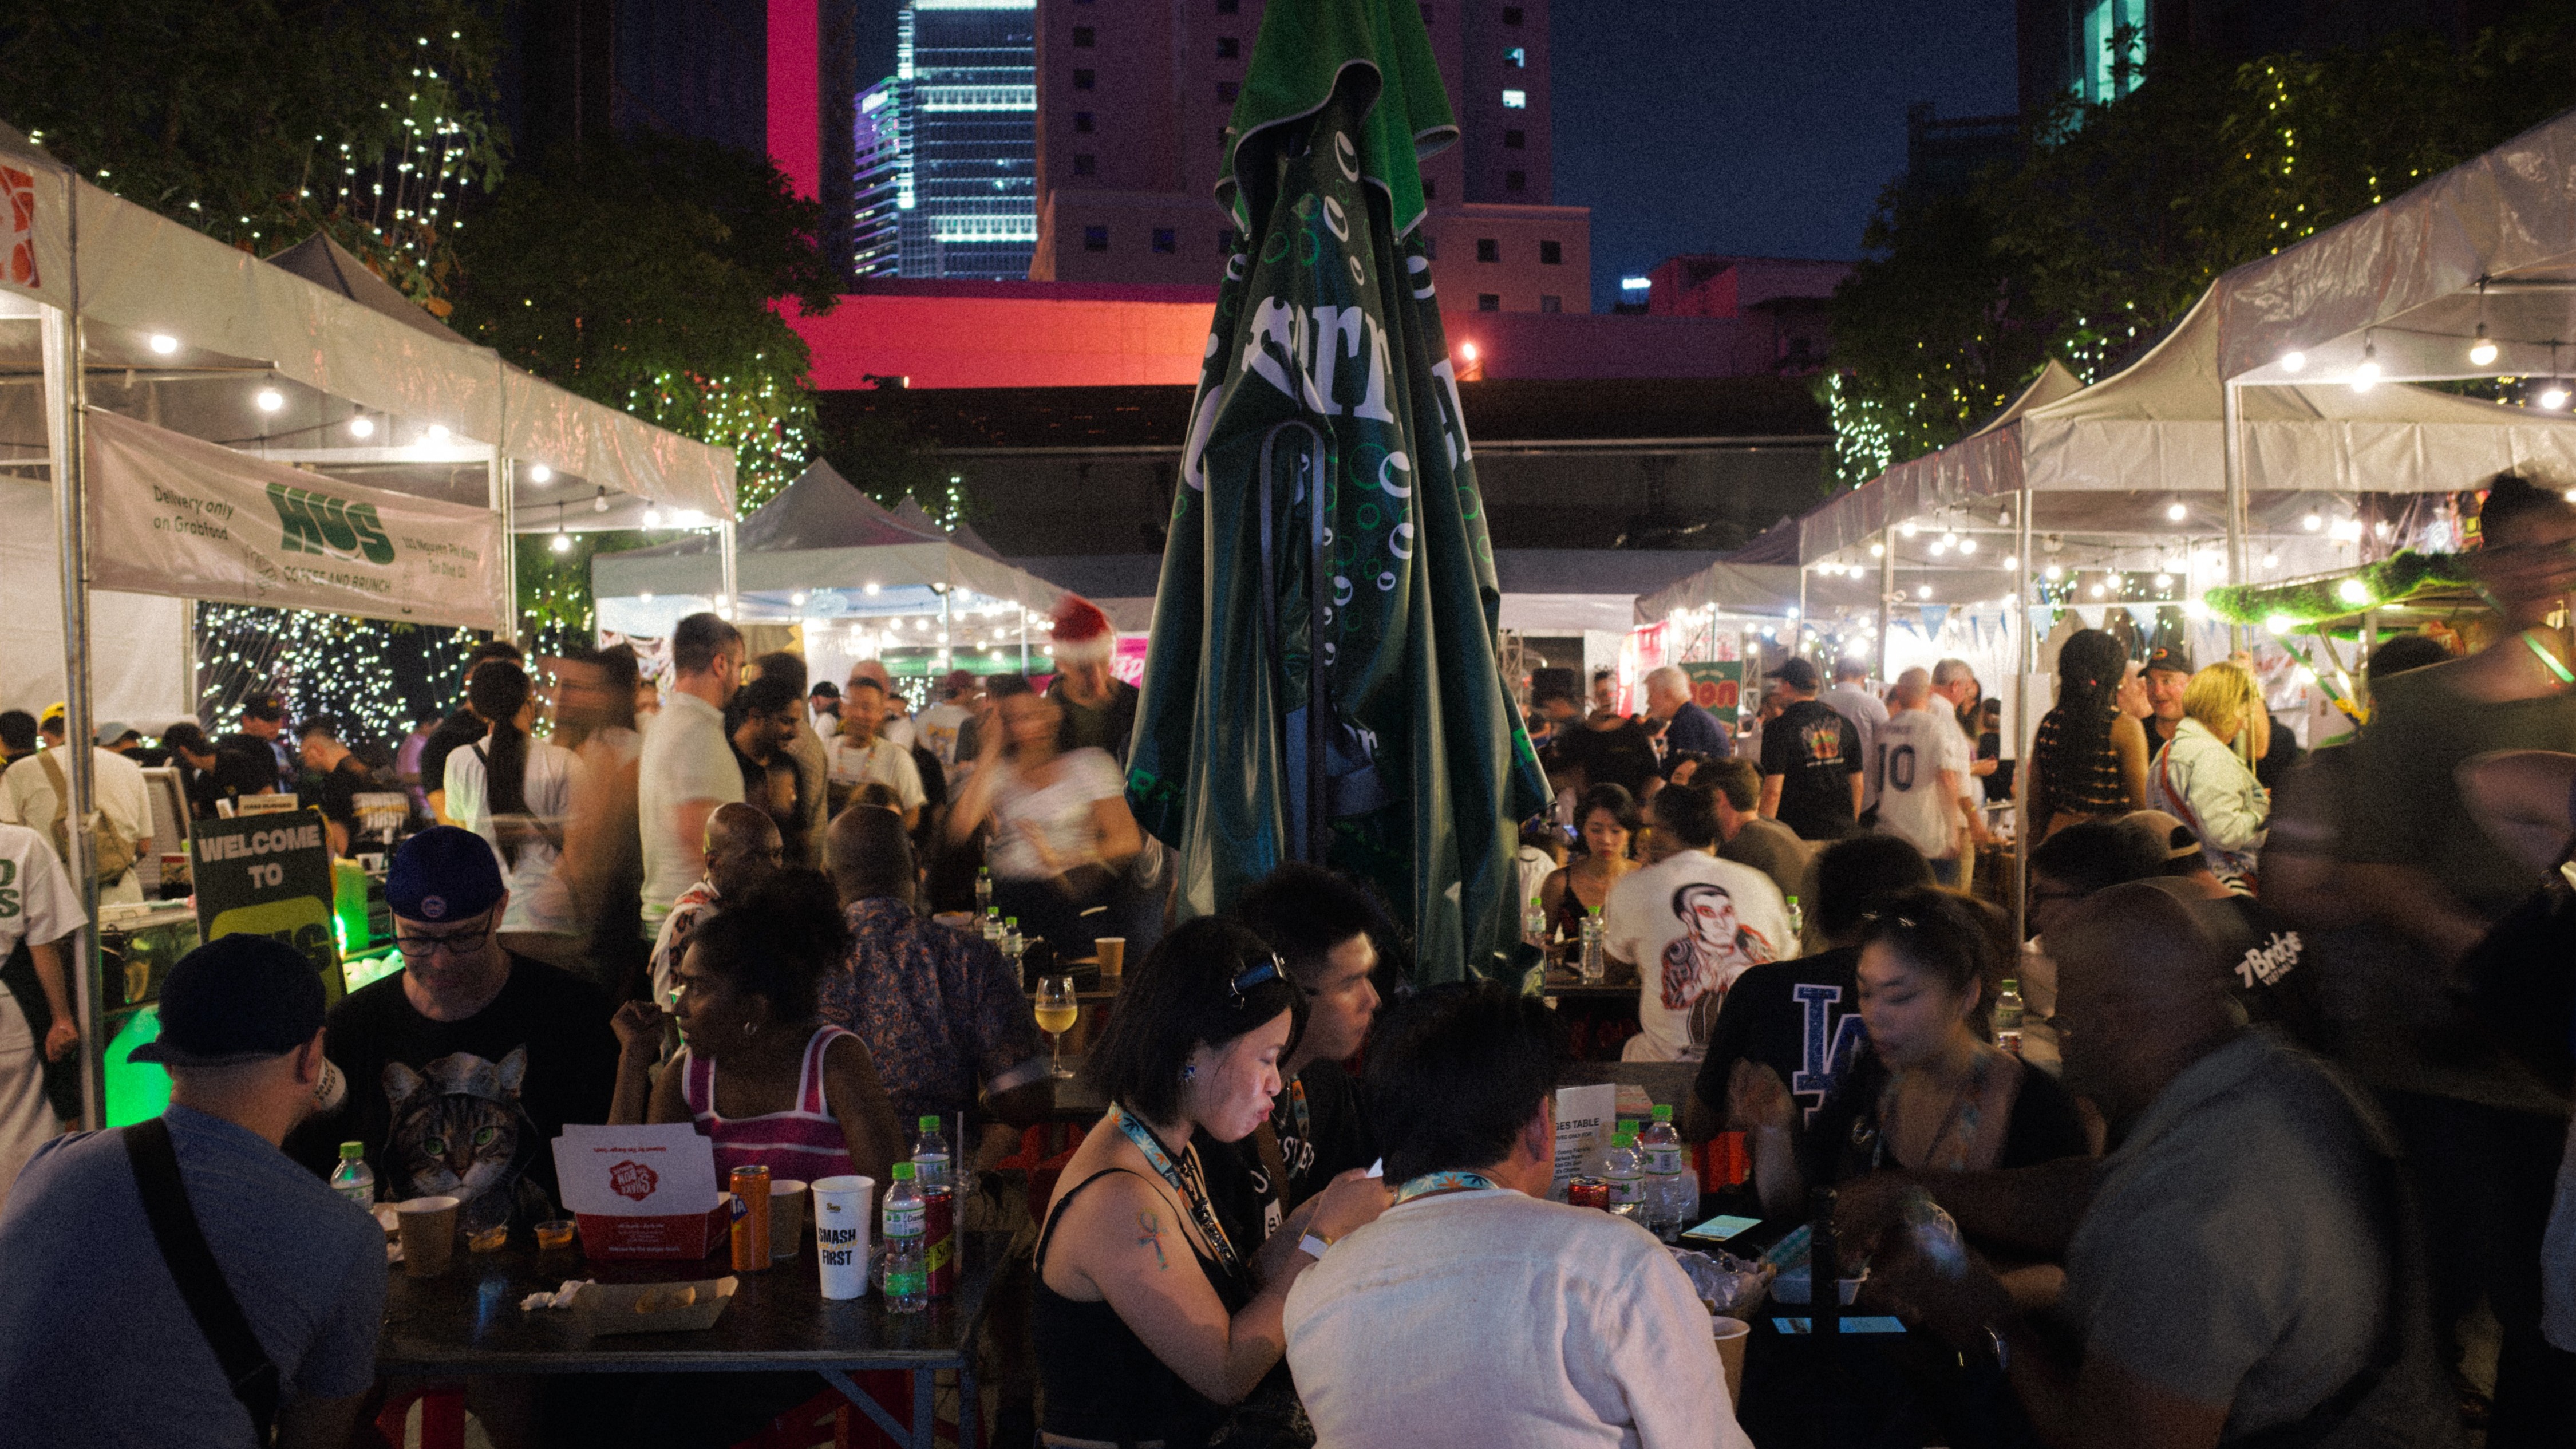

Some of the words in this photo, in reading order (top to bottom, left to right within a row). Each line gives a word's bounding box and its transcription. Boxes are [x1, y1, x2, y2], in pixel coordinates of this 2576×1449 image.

[153, 485, 202, 514] Delivery
[206, 500, 234, 521] only
[153, 516, 170, 531] on
[174, 515, 228, 540] Grabfood
[328, 571, 349, 587] AND
[351, 575, 392, 593] BRUNCH
[1876, 743, 1915, 792] 10
[198, 824, 321, 863] WELCOME
[248, 862, 284, 890] TO
[1572, 1118, 1600, 1129] TABLE
[617, 1170, 637, 1185] BUN
[621, 1172, 650, 1195] SHAKE
[819, 1227, 857, 1245] SMASH
[822, 1250, 852, 1266] FIRST
